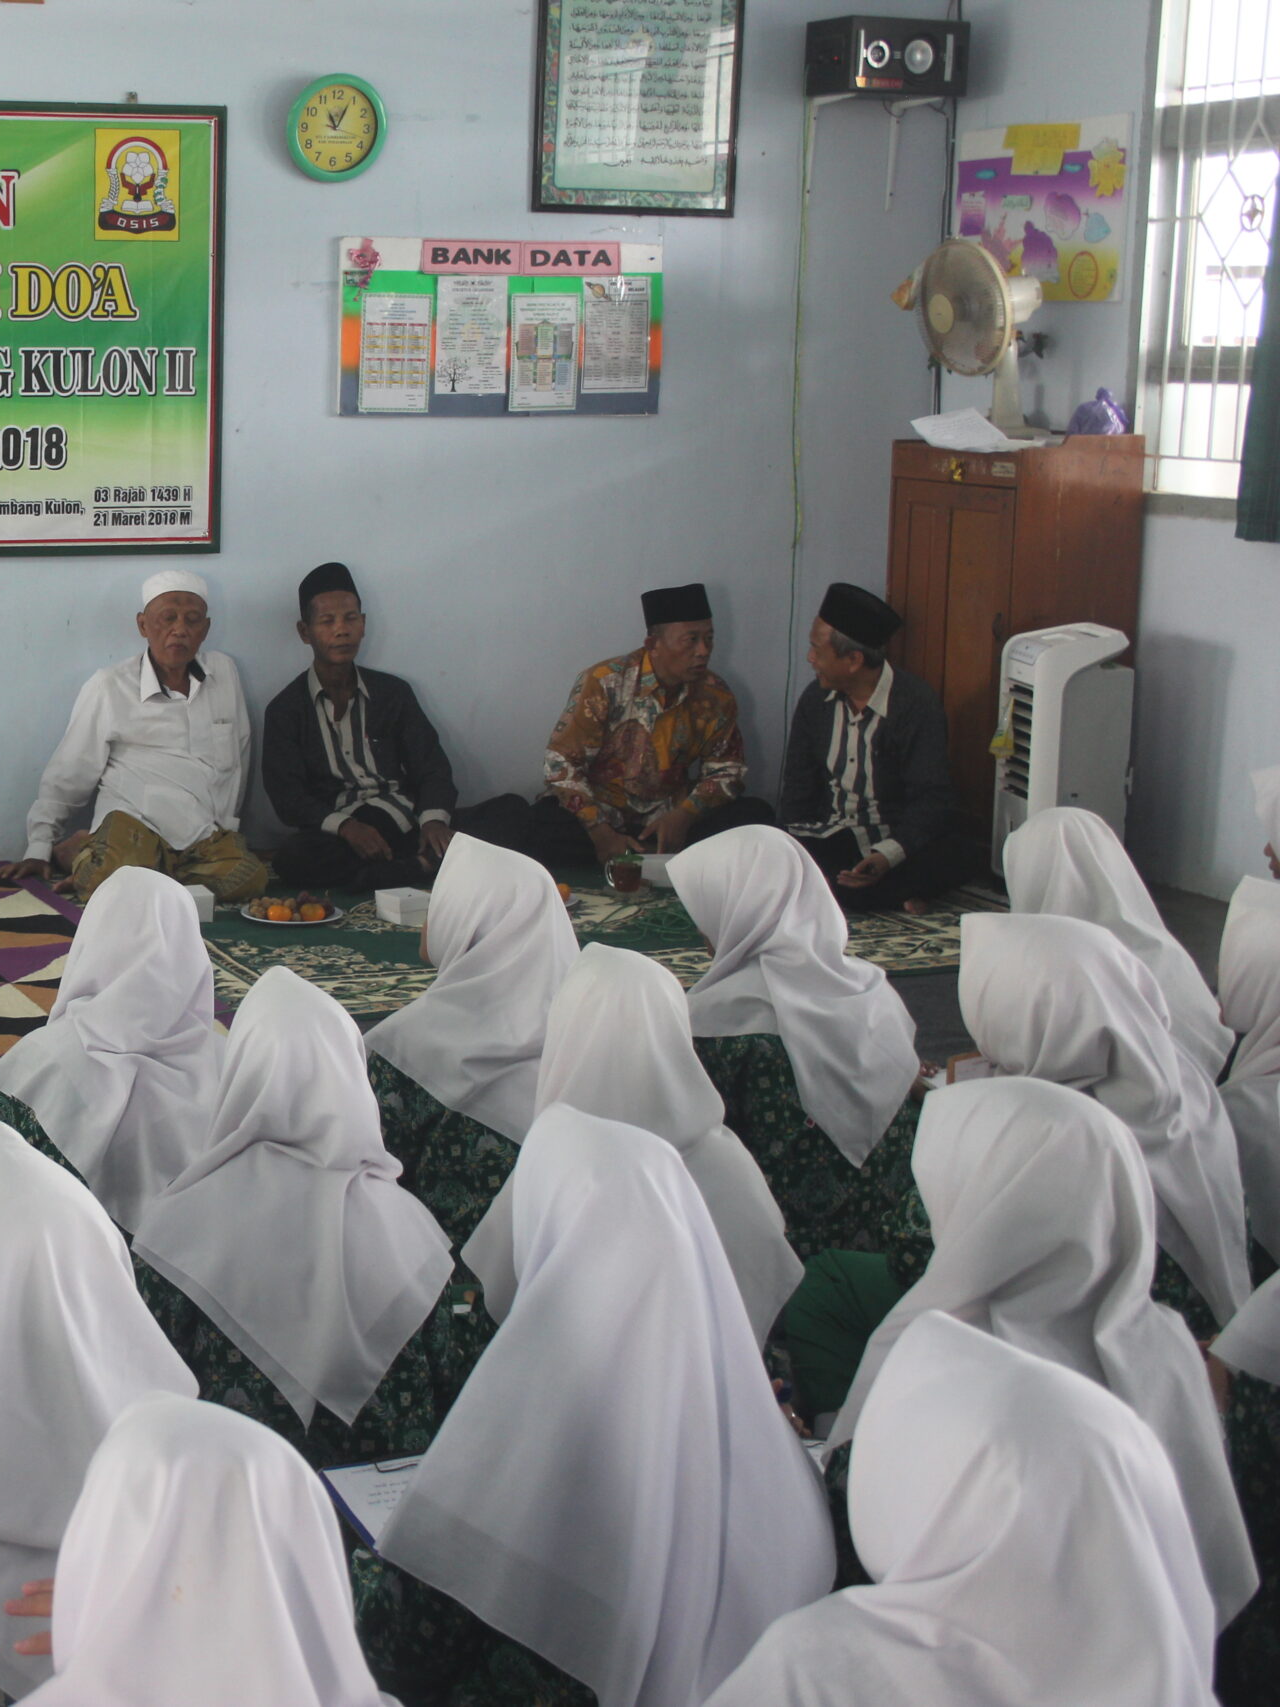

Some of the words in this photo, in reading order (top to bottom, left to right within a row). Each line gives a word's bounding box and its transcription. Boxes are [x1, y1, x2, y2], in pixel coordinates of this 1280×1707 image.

[319, 95, 328, 105] 11
[331, 89, 345, 101] 12
[306, 106, 318, 117] 10
[360, 108, 368, 119] 2
[300, 121, 309, 133] 9
[362, 123, 371, 134] 3
[304, 138, 313, 149] 8
[355, 140, 364, 150] 4
[314, 151, 322, 162] 7
[328, 156, 337, 167] 6
[344, 152, 353, 163] 5
[117, 216, 160, 229] OSIS
[430, 246, 513, 266] BANK
[529, 248, 613, 267] DATA
[21, 347, 161, 397] KULON
[163, 347, 197, 396] II
[93, 487, 110, 503] 03
[113, 487, 148, 505] Rajab
[149, 486, 181, 503] 1439
[183, 486, 193, 502] H
[44, 499, 86, 516] Kulon,
[93, 511, 109, 527] 21
[111, 511, 147, 527] Maret
[147, 510, 178, 526] 2018
[179, 510, 192, 525] M
